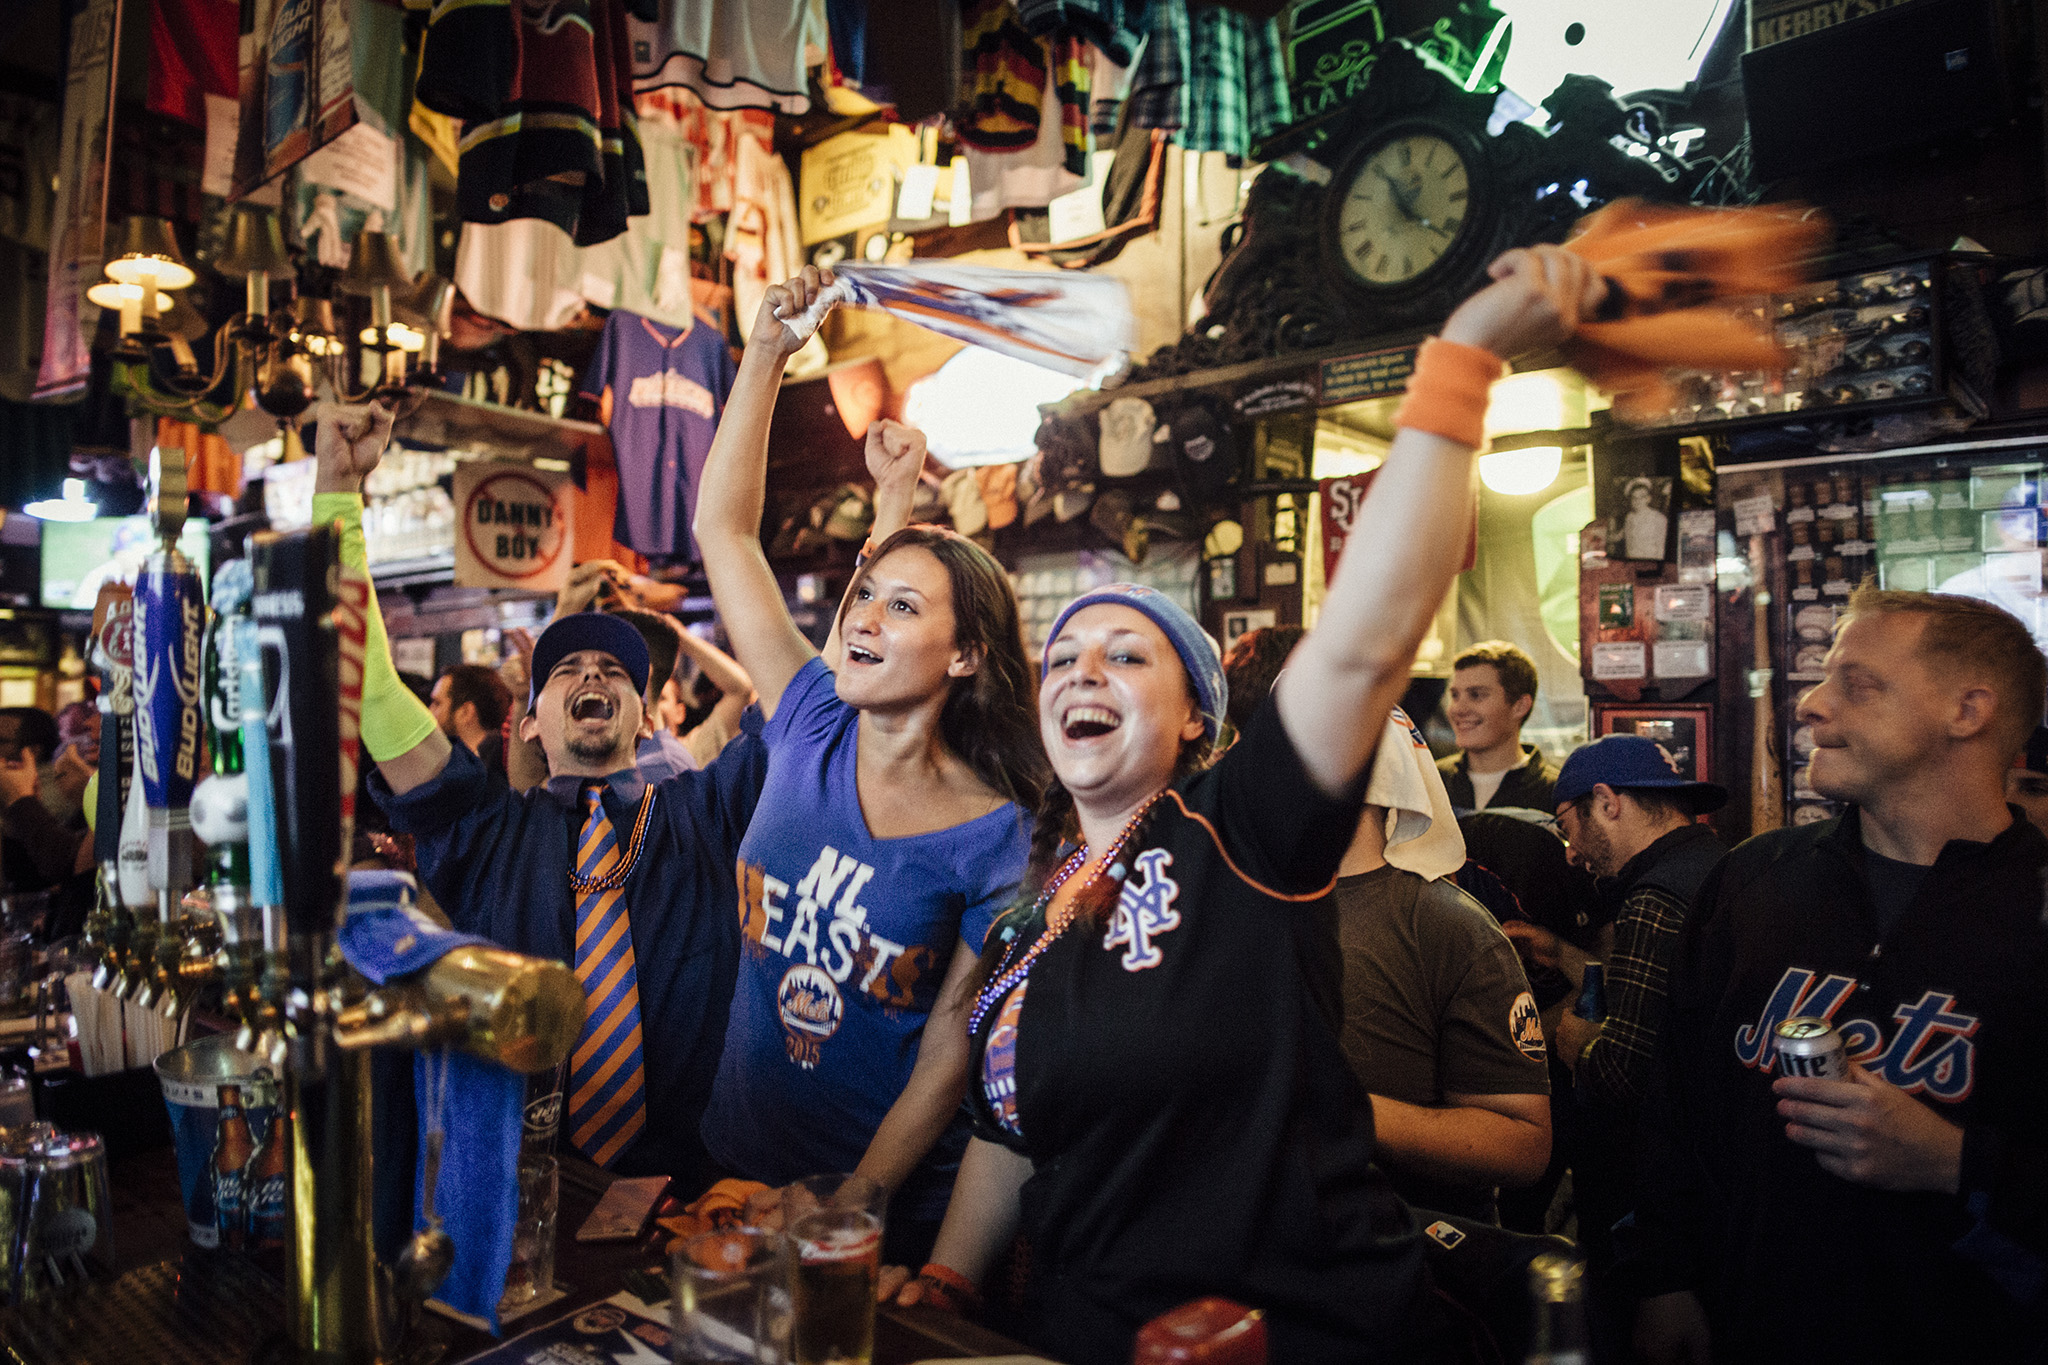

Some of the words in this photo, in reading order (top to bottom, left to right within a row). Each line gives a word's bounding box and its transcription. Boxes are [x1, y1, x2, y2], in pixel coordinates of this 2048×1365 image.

[478, 499, 553, 529] DANNY
[496, 533, 539, 560] BOY
[132, 596, 150, 704] LIGHT
[181, 596, 200, 704] LIGHT
[210, 612, 247, 732] Carlsb
[138, 704, 159, 785] BUD
[175, 707, 198, 781] BUD
[795, 844, 876, 930] NL
[785, 1034, 821, 1065] 2015
[1520, 1016, 1544, 1042] Me
[1734, 965, 1982, 1104] Mets
